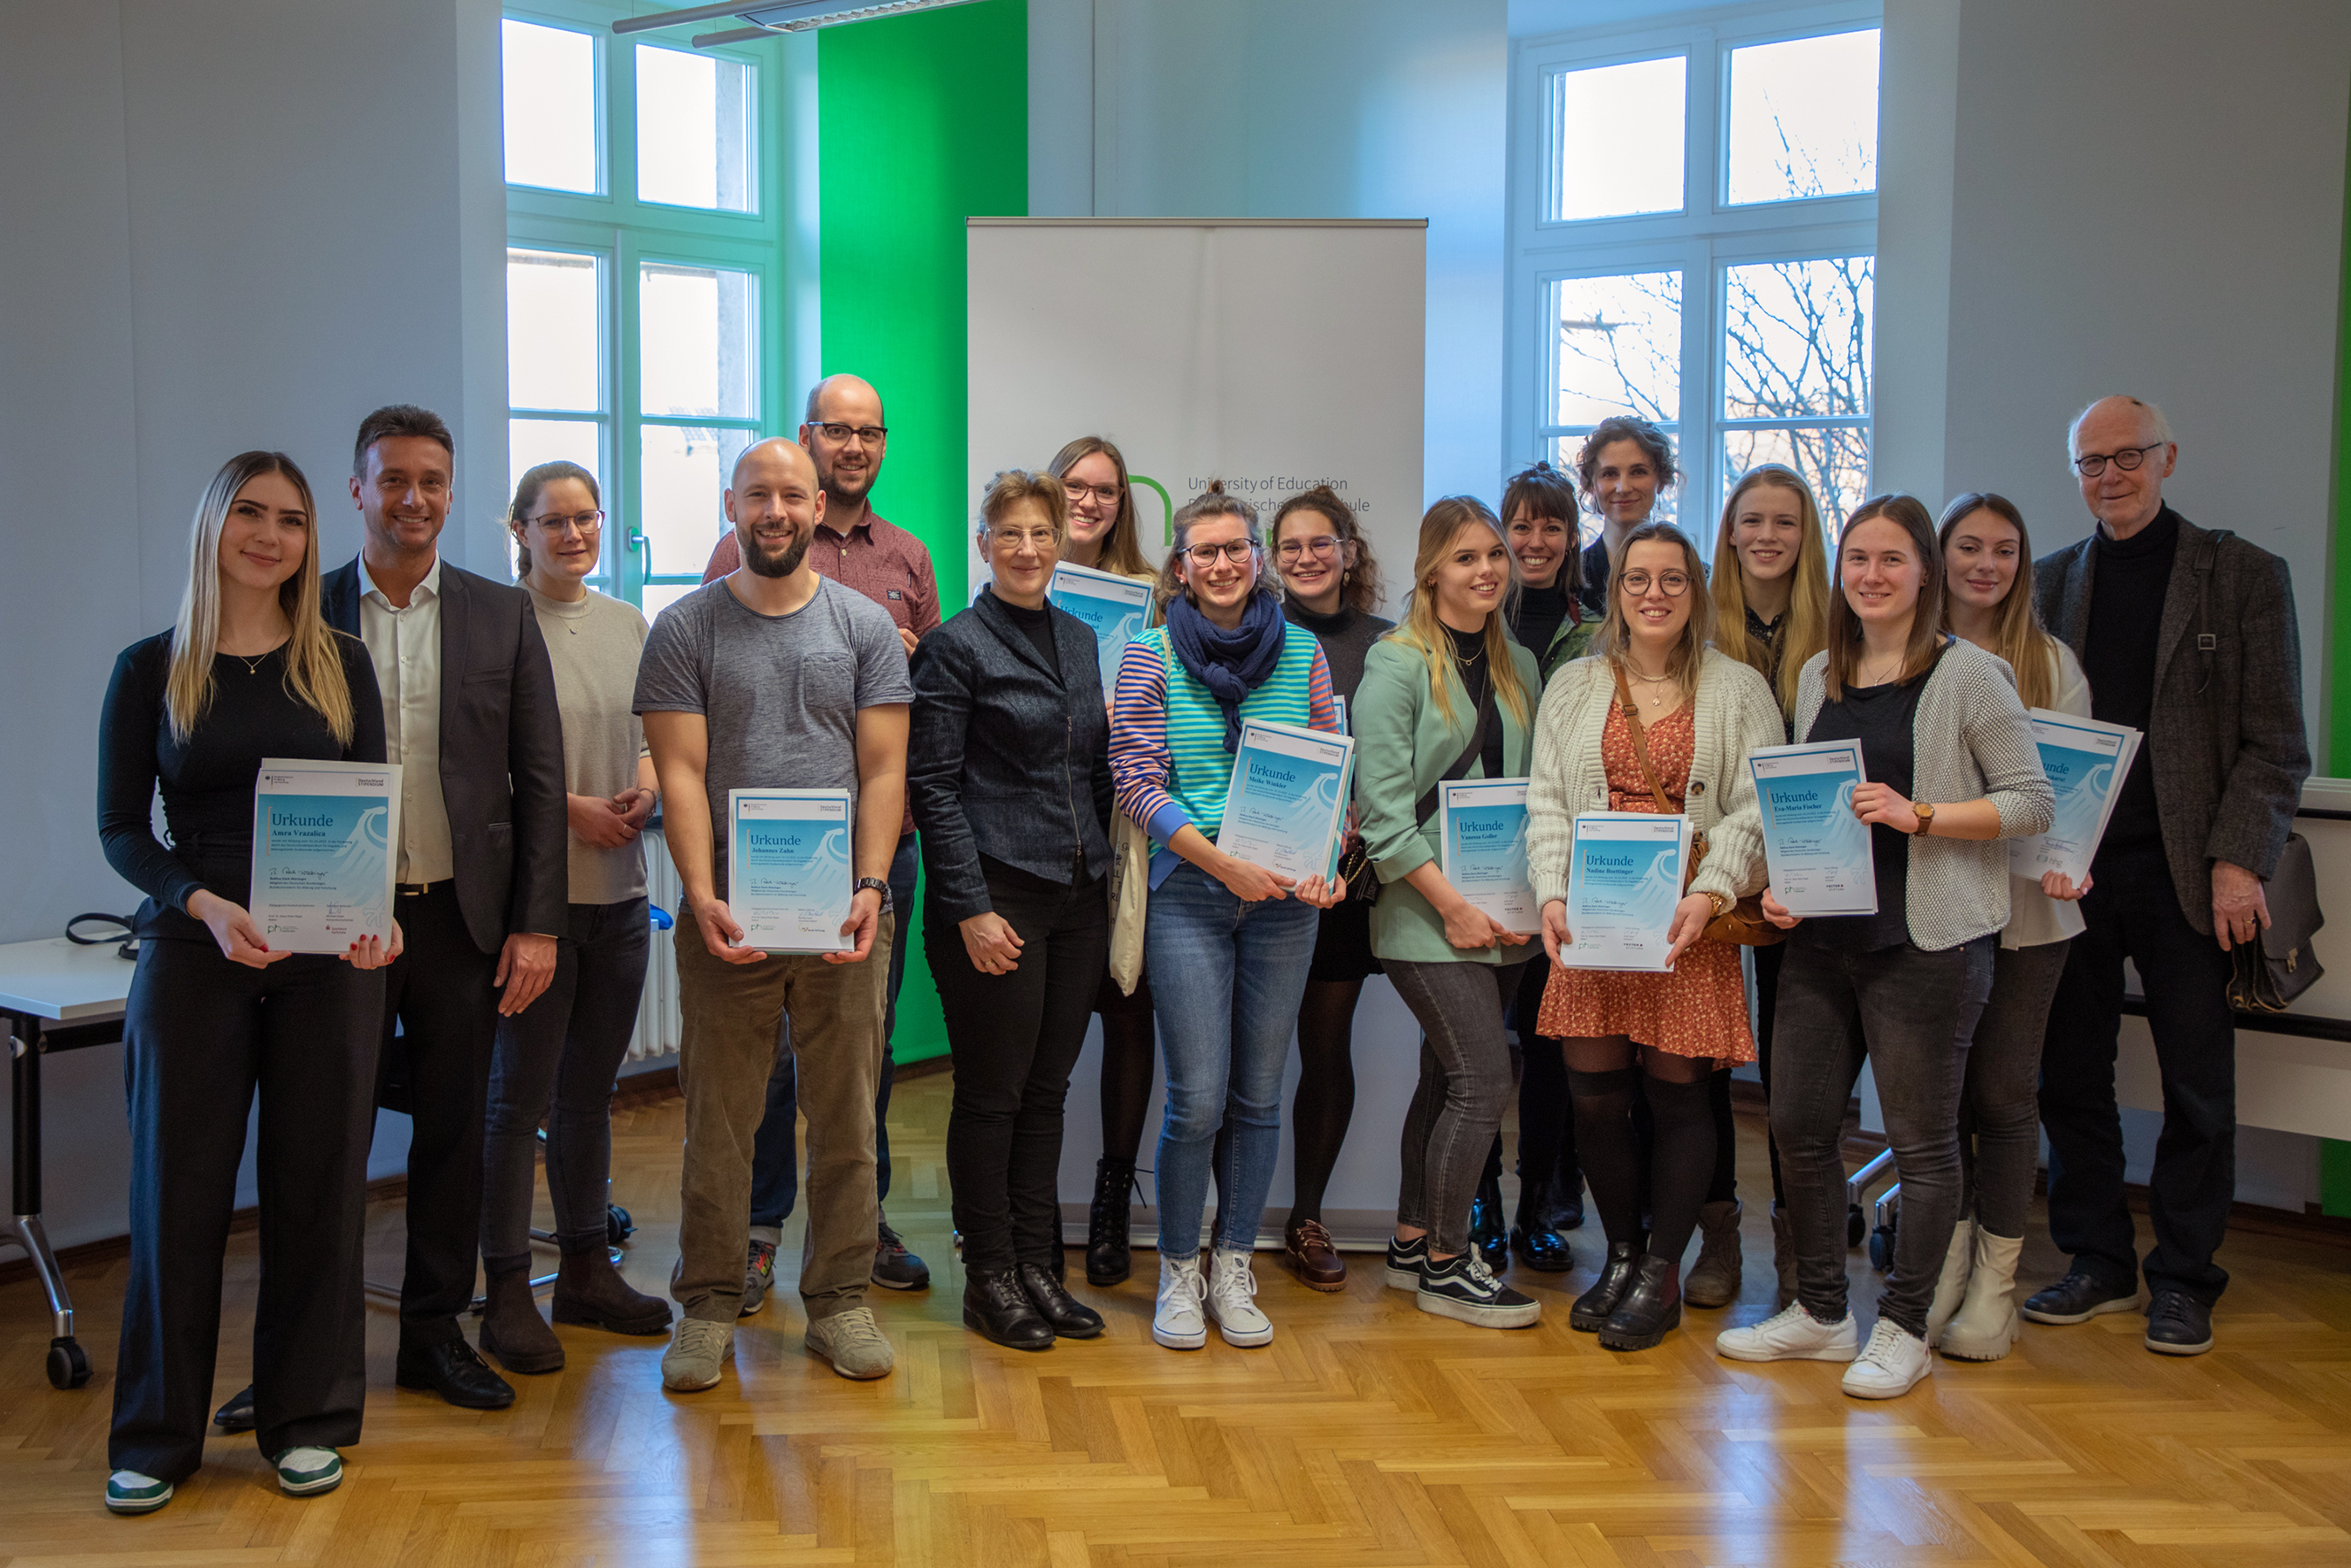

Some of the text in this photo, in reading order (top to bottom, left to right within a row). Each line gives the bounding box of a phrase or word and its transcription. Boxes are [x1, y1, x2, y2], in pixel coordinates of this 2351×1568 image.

[1188, 476, 1348, 494] Uniersity of Education
[1249, 763, 1296, 783] Urkunde
[2043, 762, 2069, 775] unde
[1248, 776, 1287, 789] Meike Winkler
[1771, 790, 1818, 803] Urkunde
[272, 813, 333, 826] Urkunde
[1460, 820, 1504, 832] Urkunde
[751, 835, 801, 846] Urkunde
[1587, 855, 1634, 866] Urkunde
